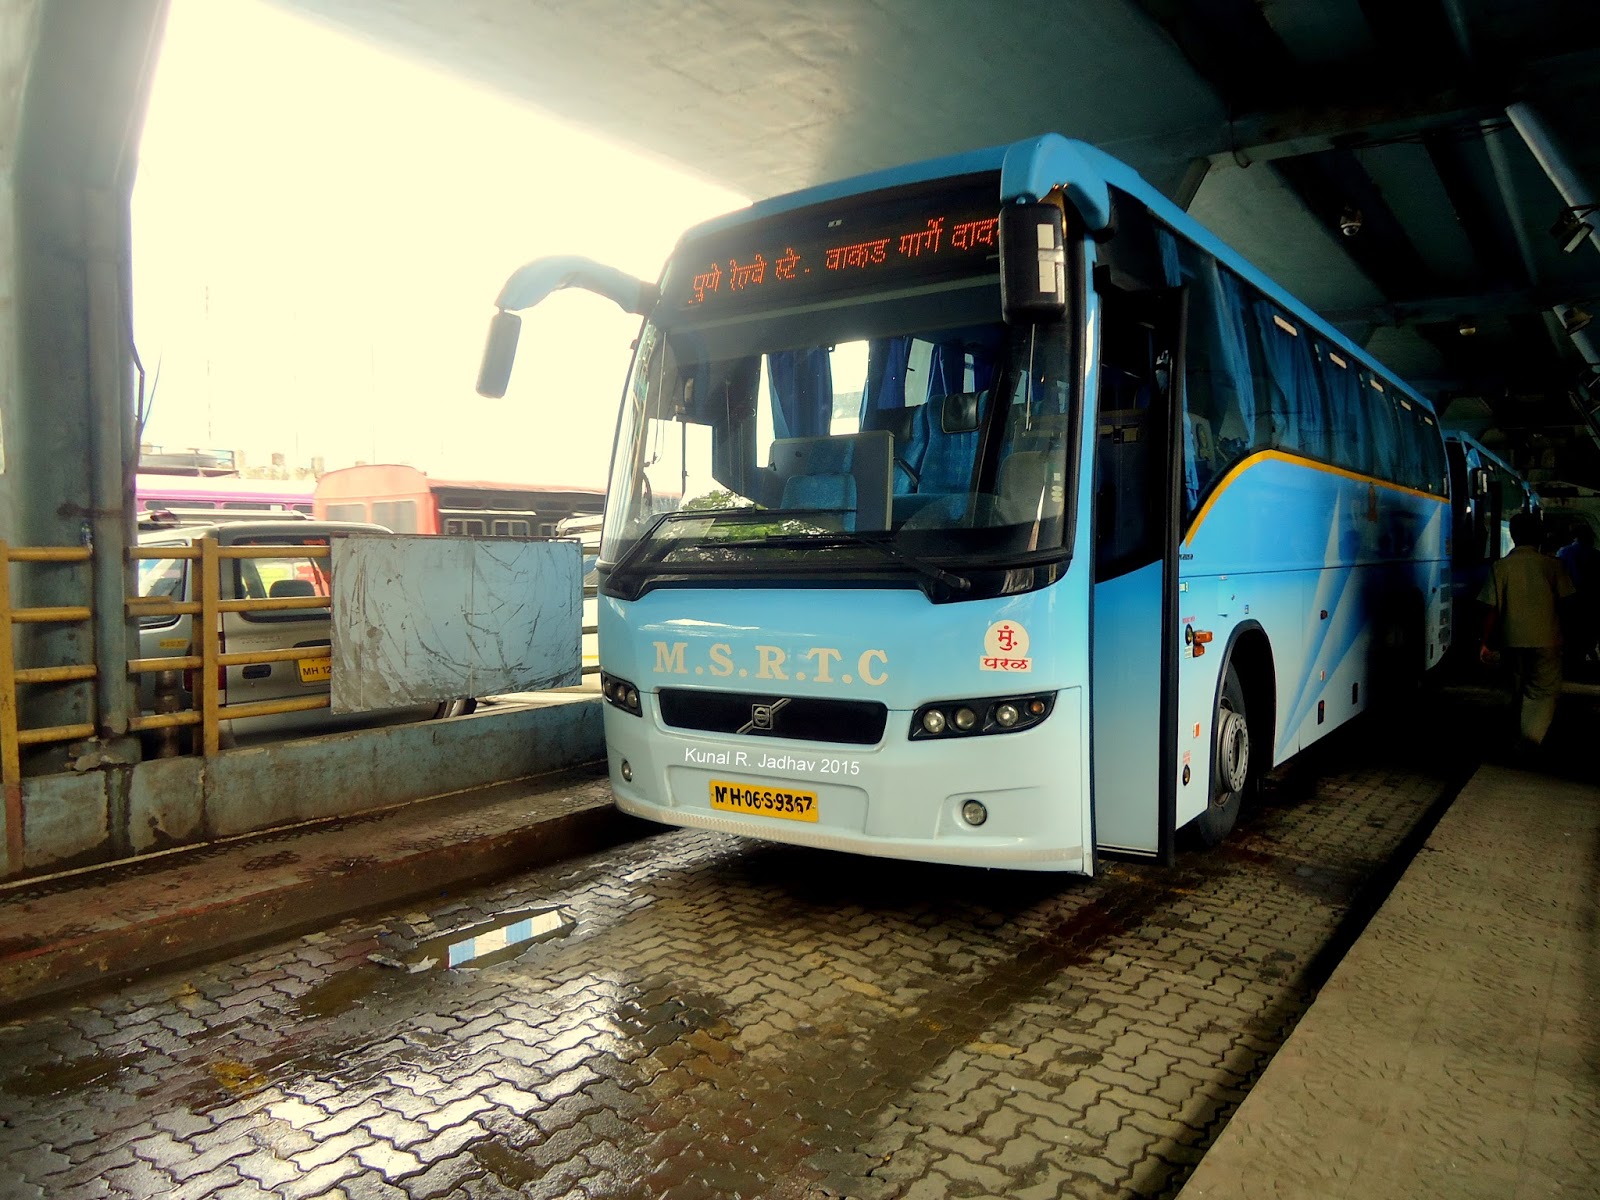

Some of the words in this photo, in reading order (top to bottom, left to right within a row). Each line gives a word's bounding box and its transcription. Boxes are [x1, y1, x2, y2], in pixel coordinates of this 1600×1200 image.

[692, 262, 722, 302] पुणे
[826, 238, 891, 270] वाकड
[951, 217, 1000, 250] दाद
[302, 666, 319, 676] MH
[652, 641, 889, 686] M.S.R.T.C
[983, 657, 1029, 671] परळ
